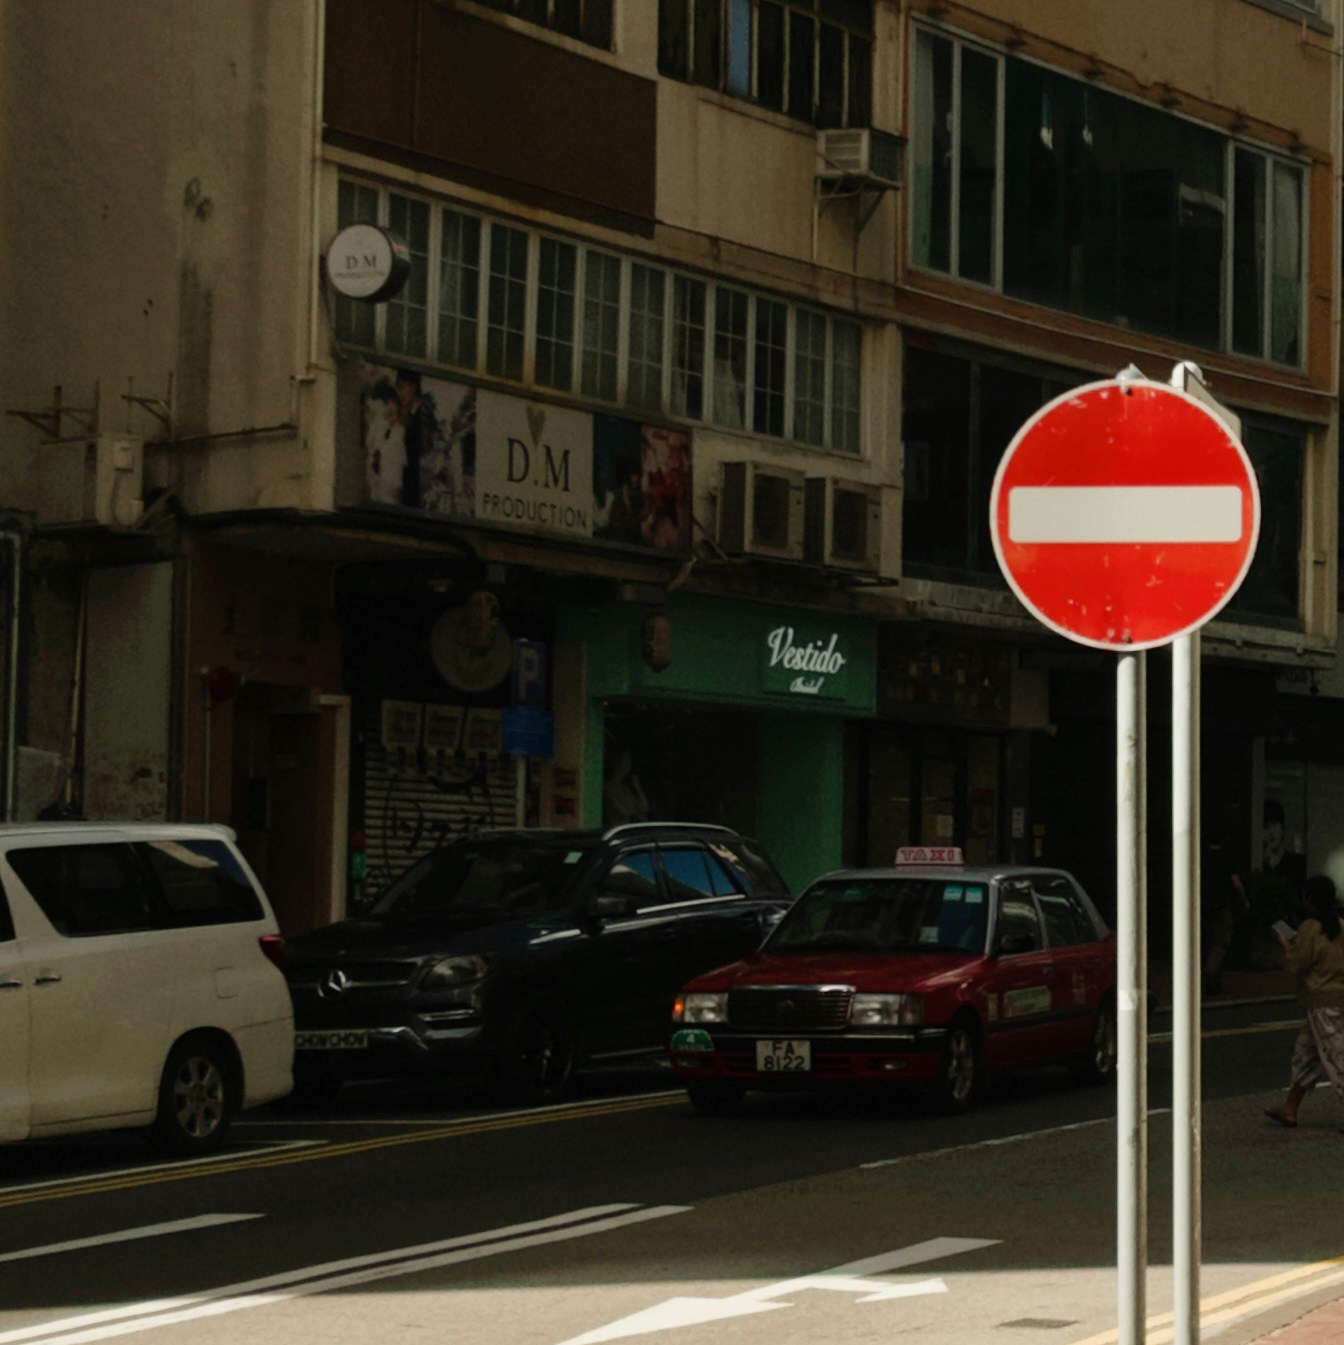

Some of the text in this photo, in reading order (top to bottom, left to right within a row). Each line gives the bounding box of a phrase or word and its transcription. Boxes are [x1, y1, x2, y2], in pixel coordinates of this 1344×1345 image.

[506, 437, 570, 492] D.M
[482, 493, 588, 529] PRODUCTION
[767, 624, 848, 675] Vestido
[518, 647, 539, 702] P
[901, 847, 955, 862] TAXI
[763, 1056, 805, 1071] 8122
[772, 1041, 795, 1056] FA
